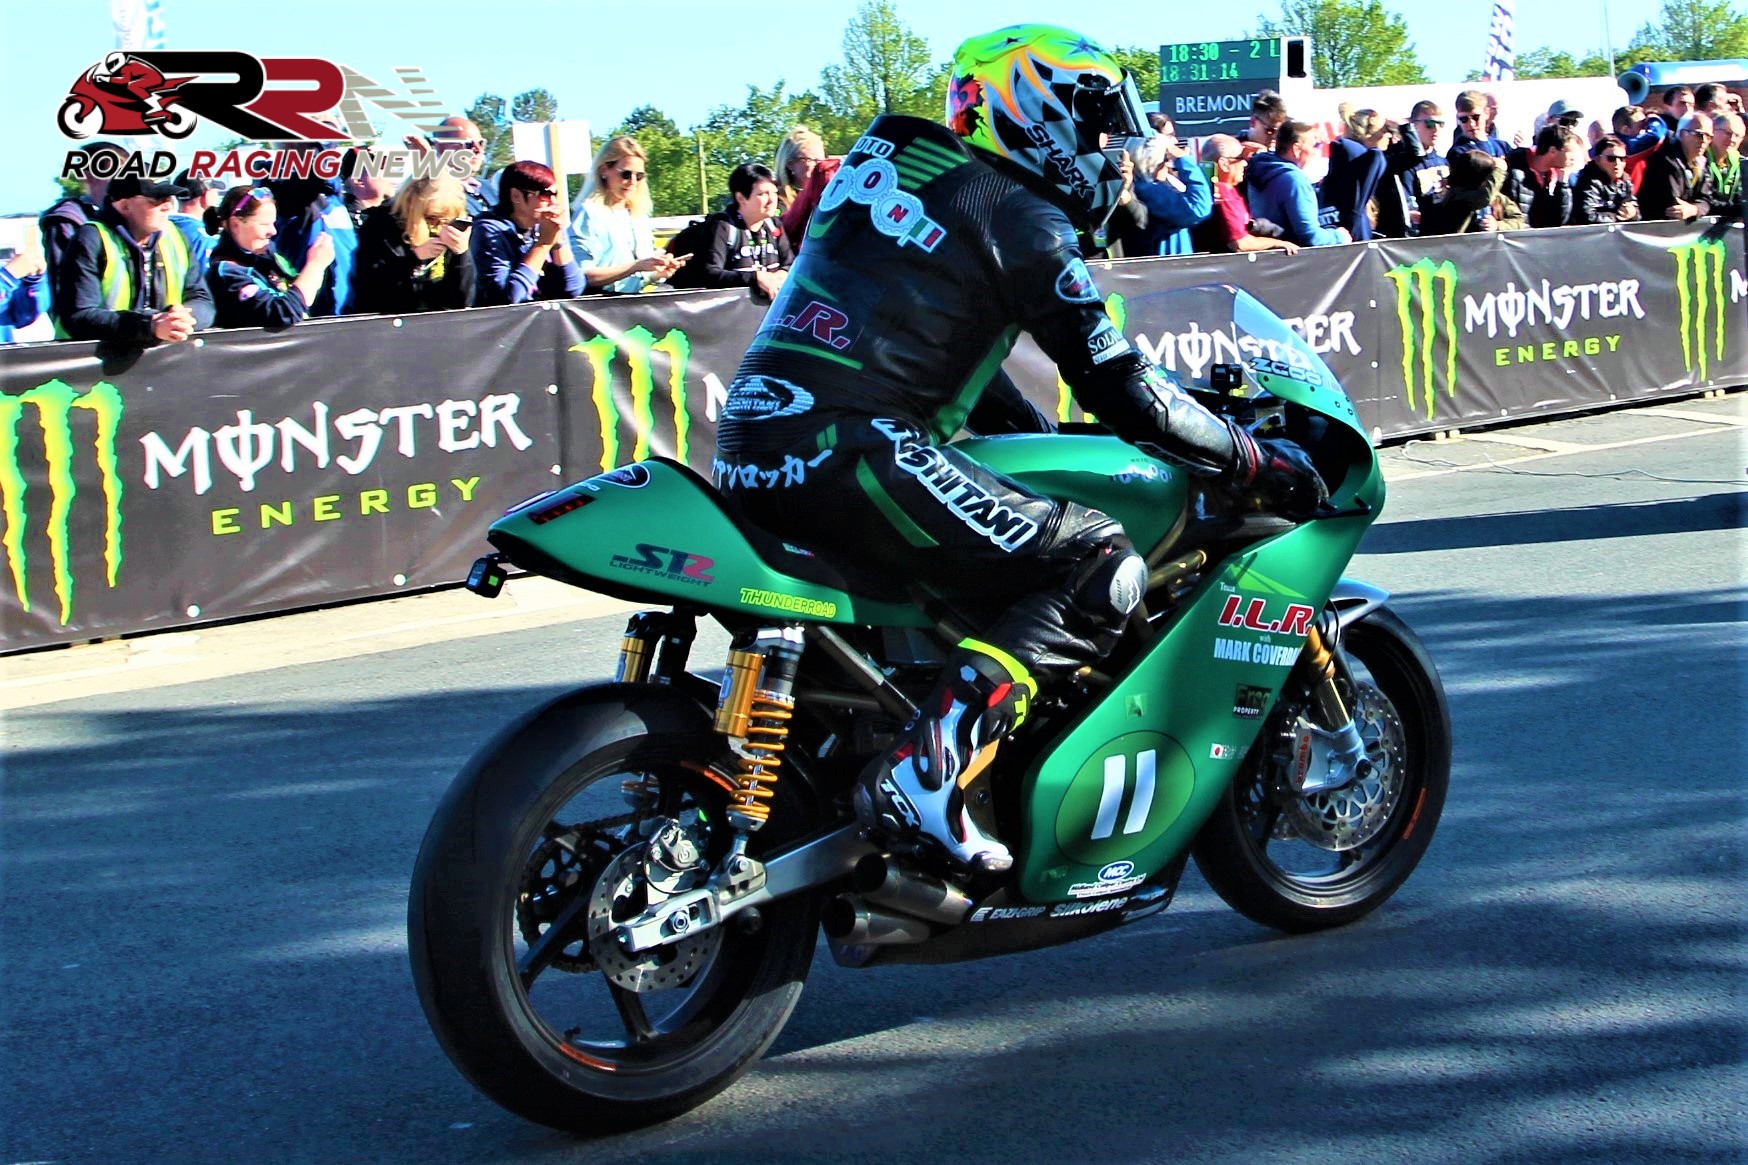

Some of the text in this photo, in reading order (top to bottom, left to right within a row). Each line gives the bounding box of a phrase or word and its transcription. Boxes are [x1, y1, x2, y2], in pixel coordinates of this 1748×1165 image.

[1169, 42, 1220, 63] 18:30
[1250, 40, 1261, 59] 2
[853, 136, 895, 158] OTO
[1024, 123, 1096, 198] SHARK
[1463, 278, 1646, 338] MONSTER
[1494, 334, 1622, 367] ENERGY
[139, 392, 533, 495] MONSTER
[210, 476, 481, 536] ENERGY
[609, 561, 714, 587] LIGHTWEIGHT
[740, 588, 837, 618] THUNDERROAD
[1213, 638, 1252, 662] MARK
[1232, 706, 1260, 715] PROPERTY
[1091, 749, 1156, 840] 11
